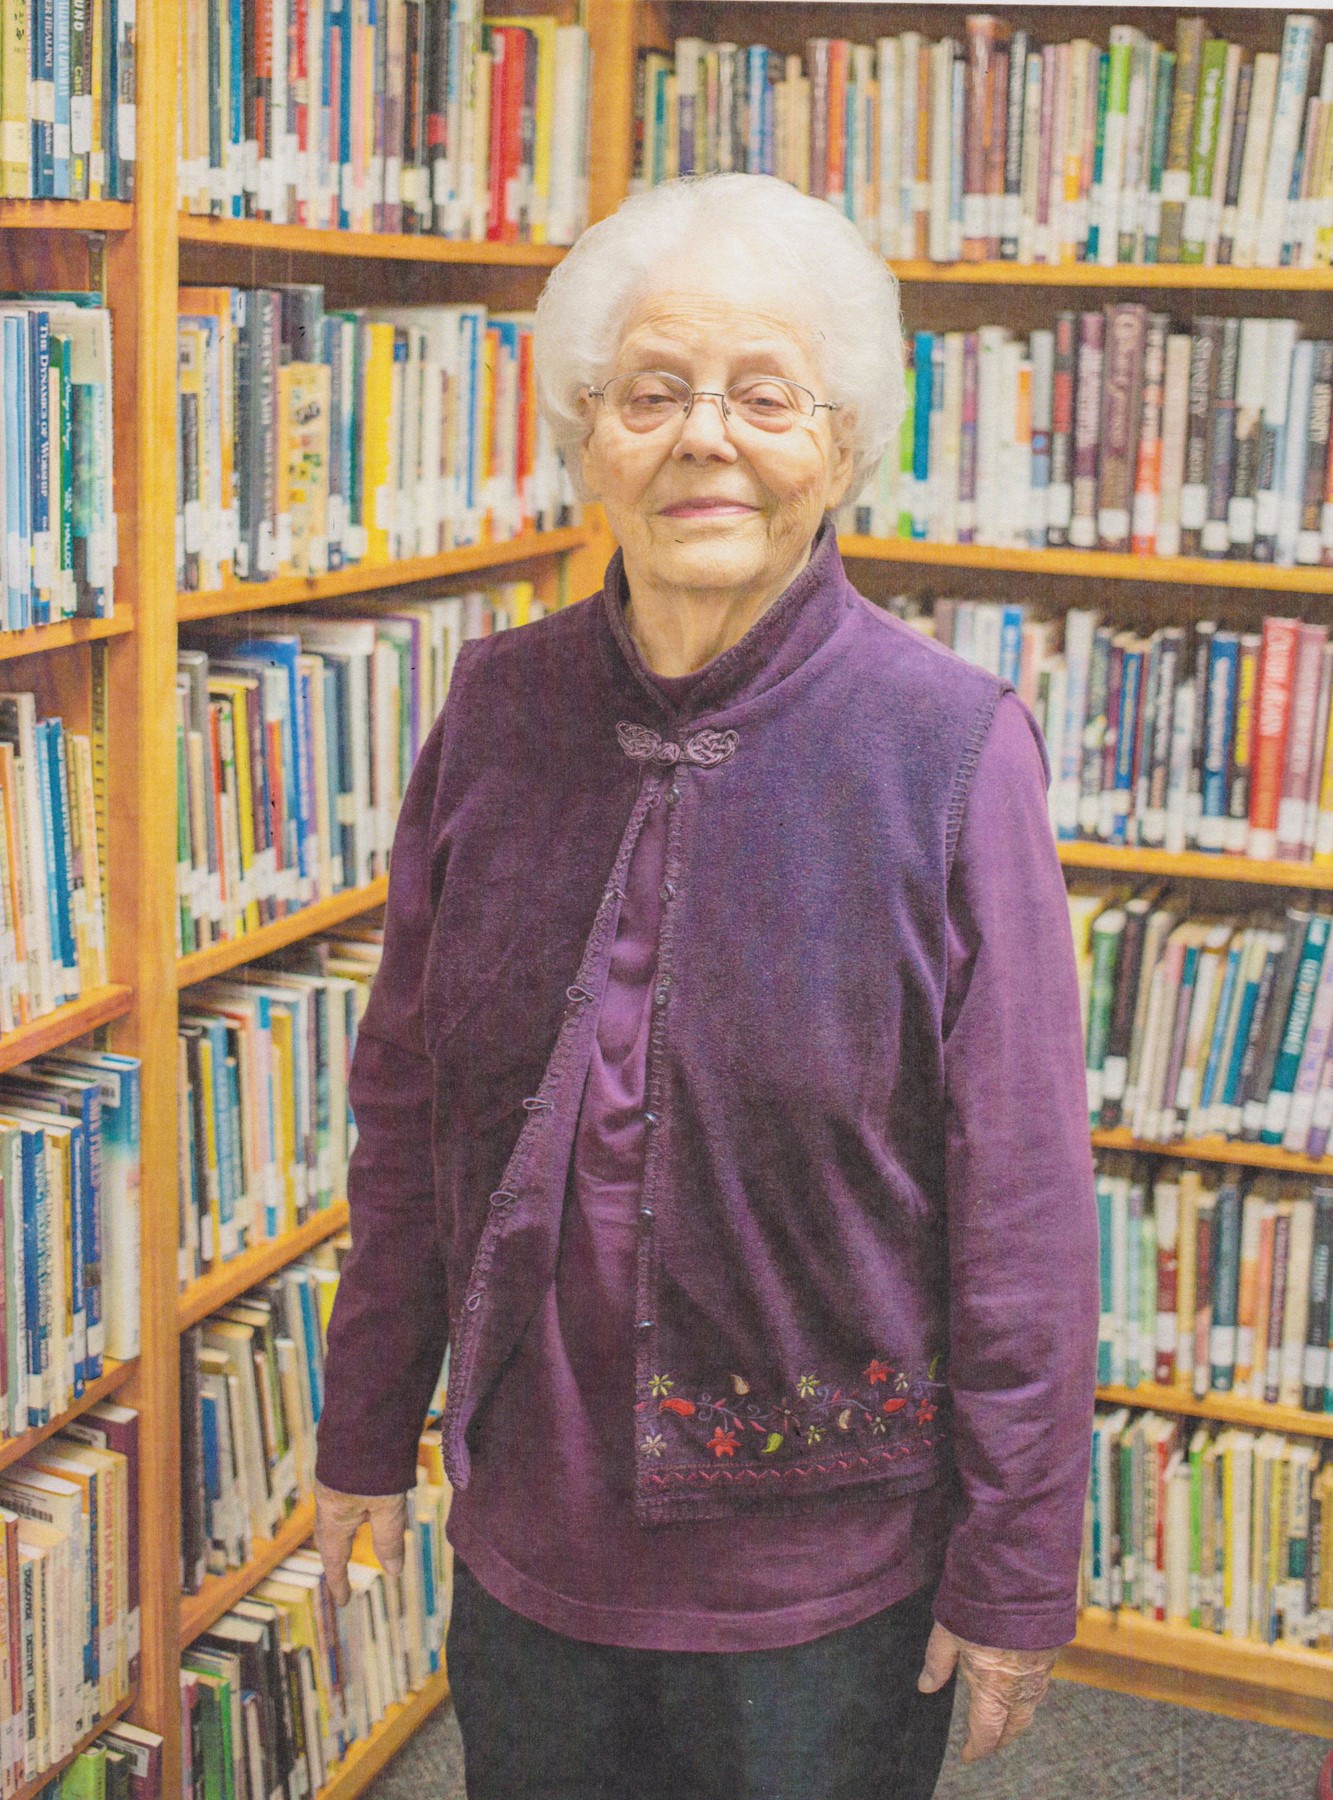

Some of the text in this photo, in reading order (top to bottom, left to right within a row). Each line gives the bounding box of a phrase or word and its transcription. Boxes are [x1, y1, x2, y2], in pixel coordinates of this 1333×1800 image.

[44, 16, 53, 67] HEALING
[40, 324, 49, 497] THE DYNAMICS OF WORSHIP
[64, 522, 72, 569] HALLOC
